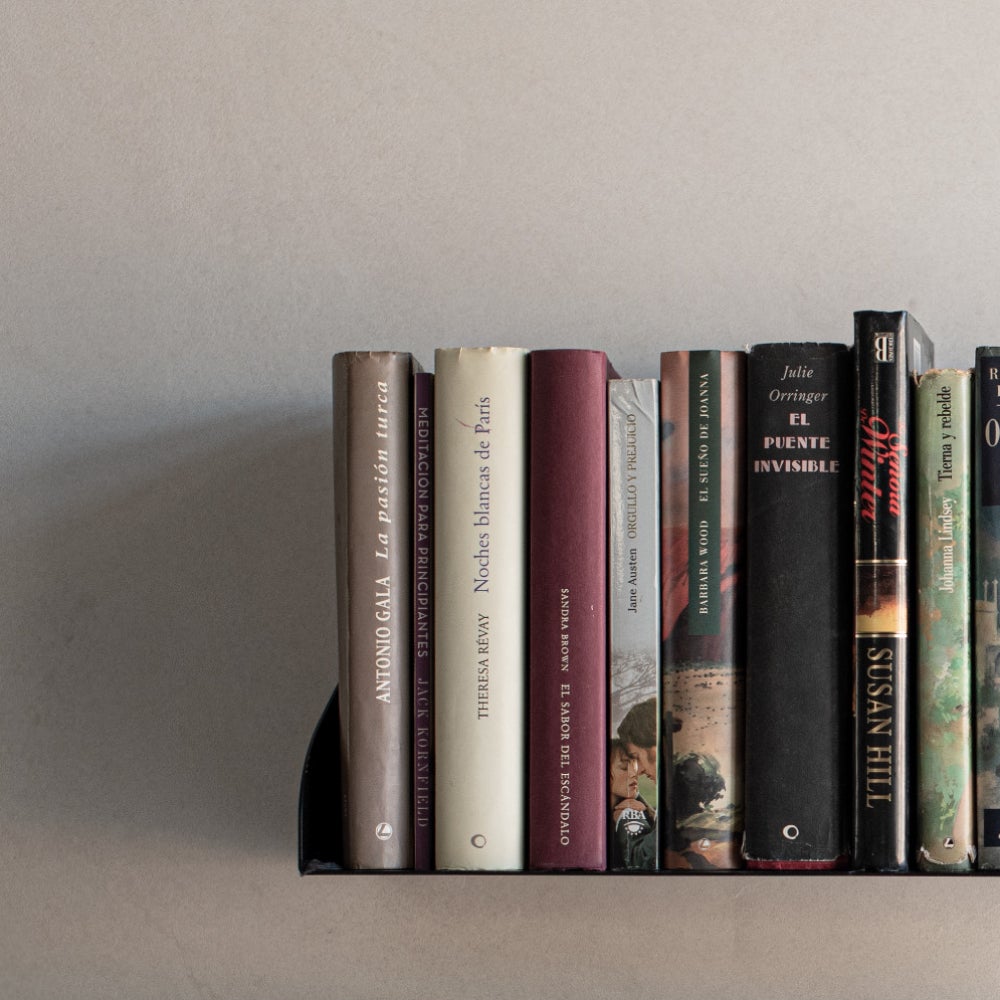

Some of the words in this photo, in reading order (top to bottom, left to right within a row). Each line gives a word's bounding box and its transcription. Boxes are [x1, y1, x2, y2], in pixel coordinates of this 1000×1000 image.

[781, 365, 814, 380] Julie
[375, 381, 389, 439] turca
[474, 397, 490, 434] París
[699, 373, 708, 418] JOANNA
[769, 389, 828, 404] Orringer
[936, 386, 952, 429] rebelde
[699, 423, 708, 439] DE
[789, 413, 811, 426] EL
[941, 432, 956, 440] y
[473, 441, 490, 460] de
[626, 413, 637, 471] PREJUICIO
[763, 436, 830, 449] PUENTE
[697, 444, 709, 484] SUEÑO
[754, 460, 840, 473] INVISIBLE
[860, 416, 890, 524] Winter
[937, 444, 953, 482] Tierna
[373, 449, 392, 524] pasión
[473, 466, 490, 526] blancas
[699, 487, 708, 501] EL
[626, 485, 637, 539] ORGULLO
[937, 497, 957, 541] Lindsey
[375, 533, 389, 560] La
[699, 520, 708, 555] WOOD
[473, 533, 490, 593] Noches
[627, 548, 638, 586] Austen
[938, 545, 954, 593] Johanna
[375, 576, 391, 622] GALA
[627, 589, 637, 613] Jane
[699, 560, 708, 614] BARBARA
[560, 588, 570, 630] SANDRA
[475, 613, 489, 654] RÉVAY
[560, 634, 570, 671] BROWN
[375, 626, 391, 704] ANTONIO
[477, 658, 489, 720] THERESA
[561, 684, 571, 698] EL
[866, 647, 893, 736] SUSAN
[560, 702, 571, 740] SABOR
[560, 745, 571, 768] DEL
[866, 745, 893, 808] HILL
[560, 773, 572, 846] ESCÁNDALO
[622, 810, 647, 820] RBA
